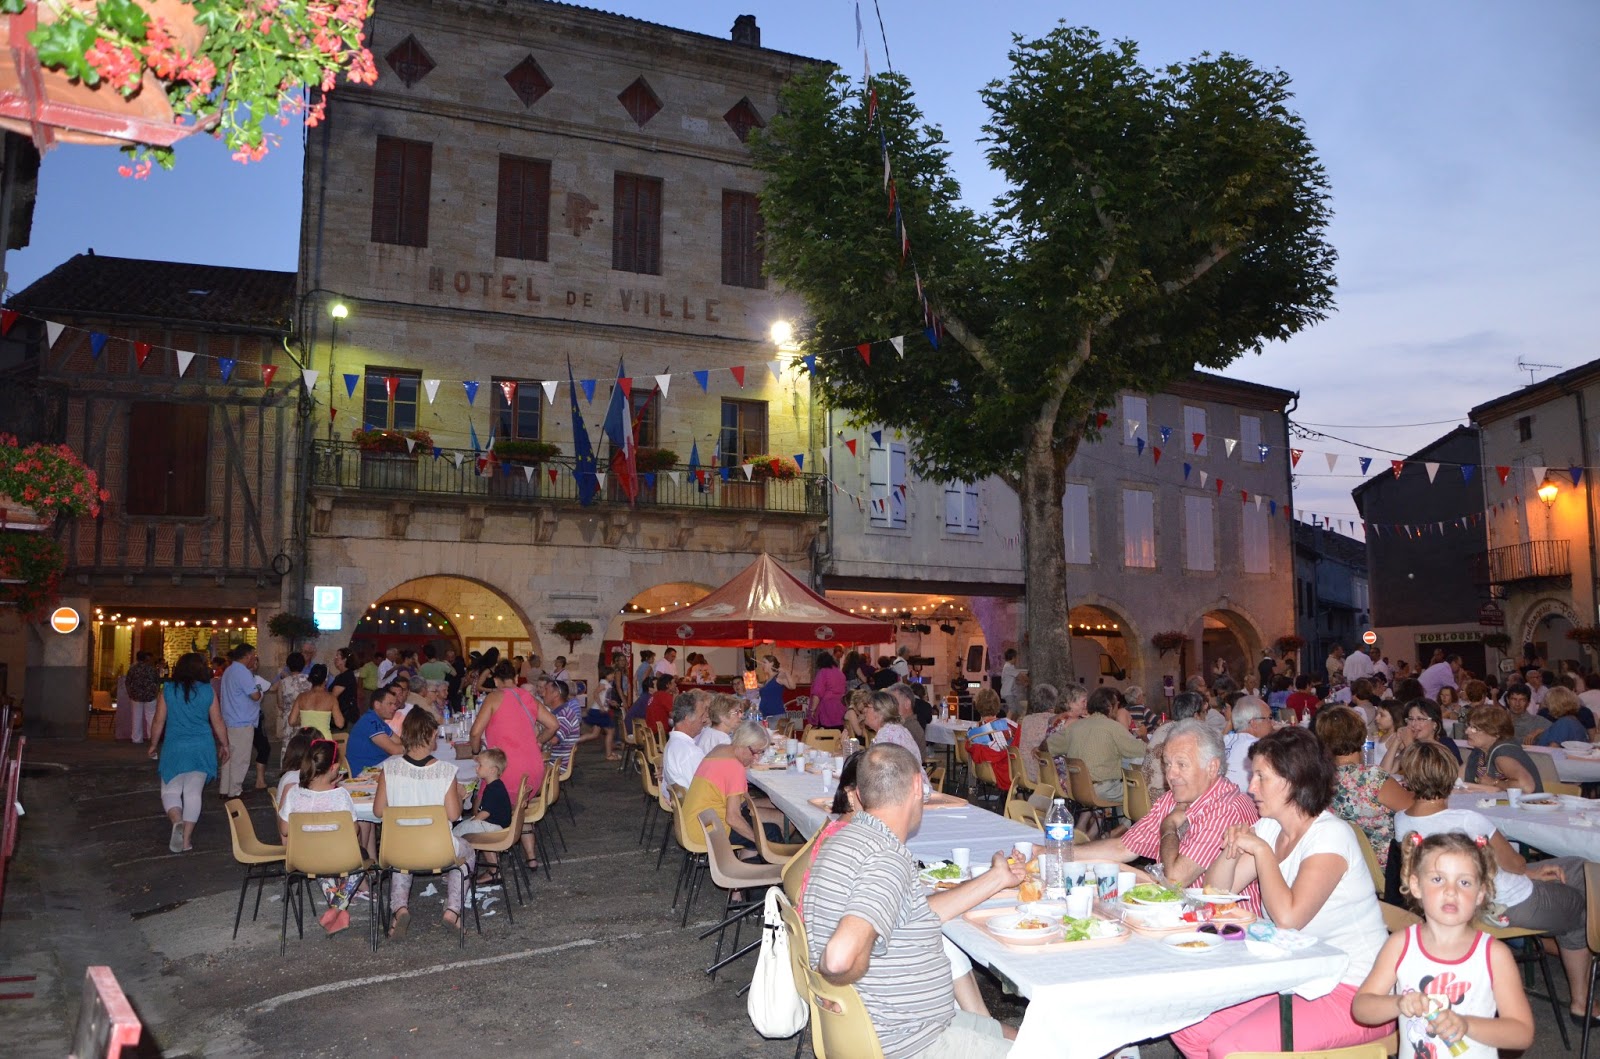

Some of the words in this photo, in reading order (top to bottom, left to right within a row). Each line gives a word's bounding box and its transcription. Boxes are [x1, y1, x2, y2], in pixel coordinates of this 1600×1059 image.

[428, 265, 541, 302] HOTEL
[566, 290, 593, 308] DE
[619, 287, 721, 322] VILLE
[321, 592, 334, 609] P
